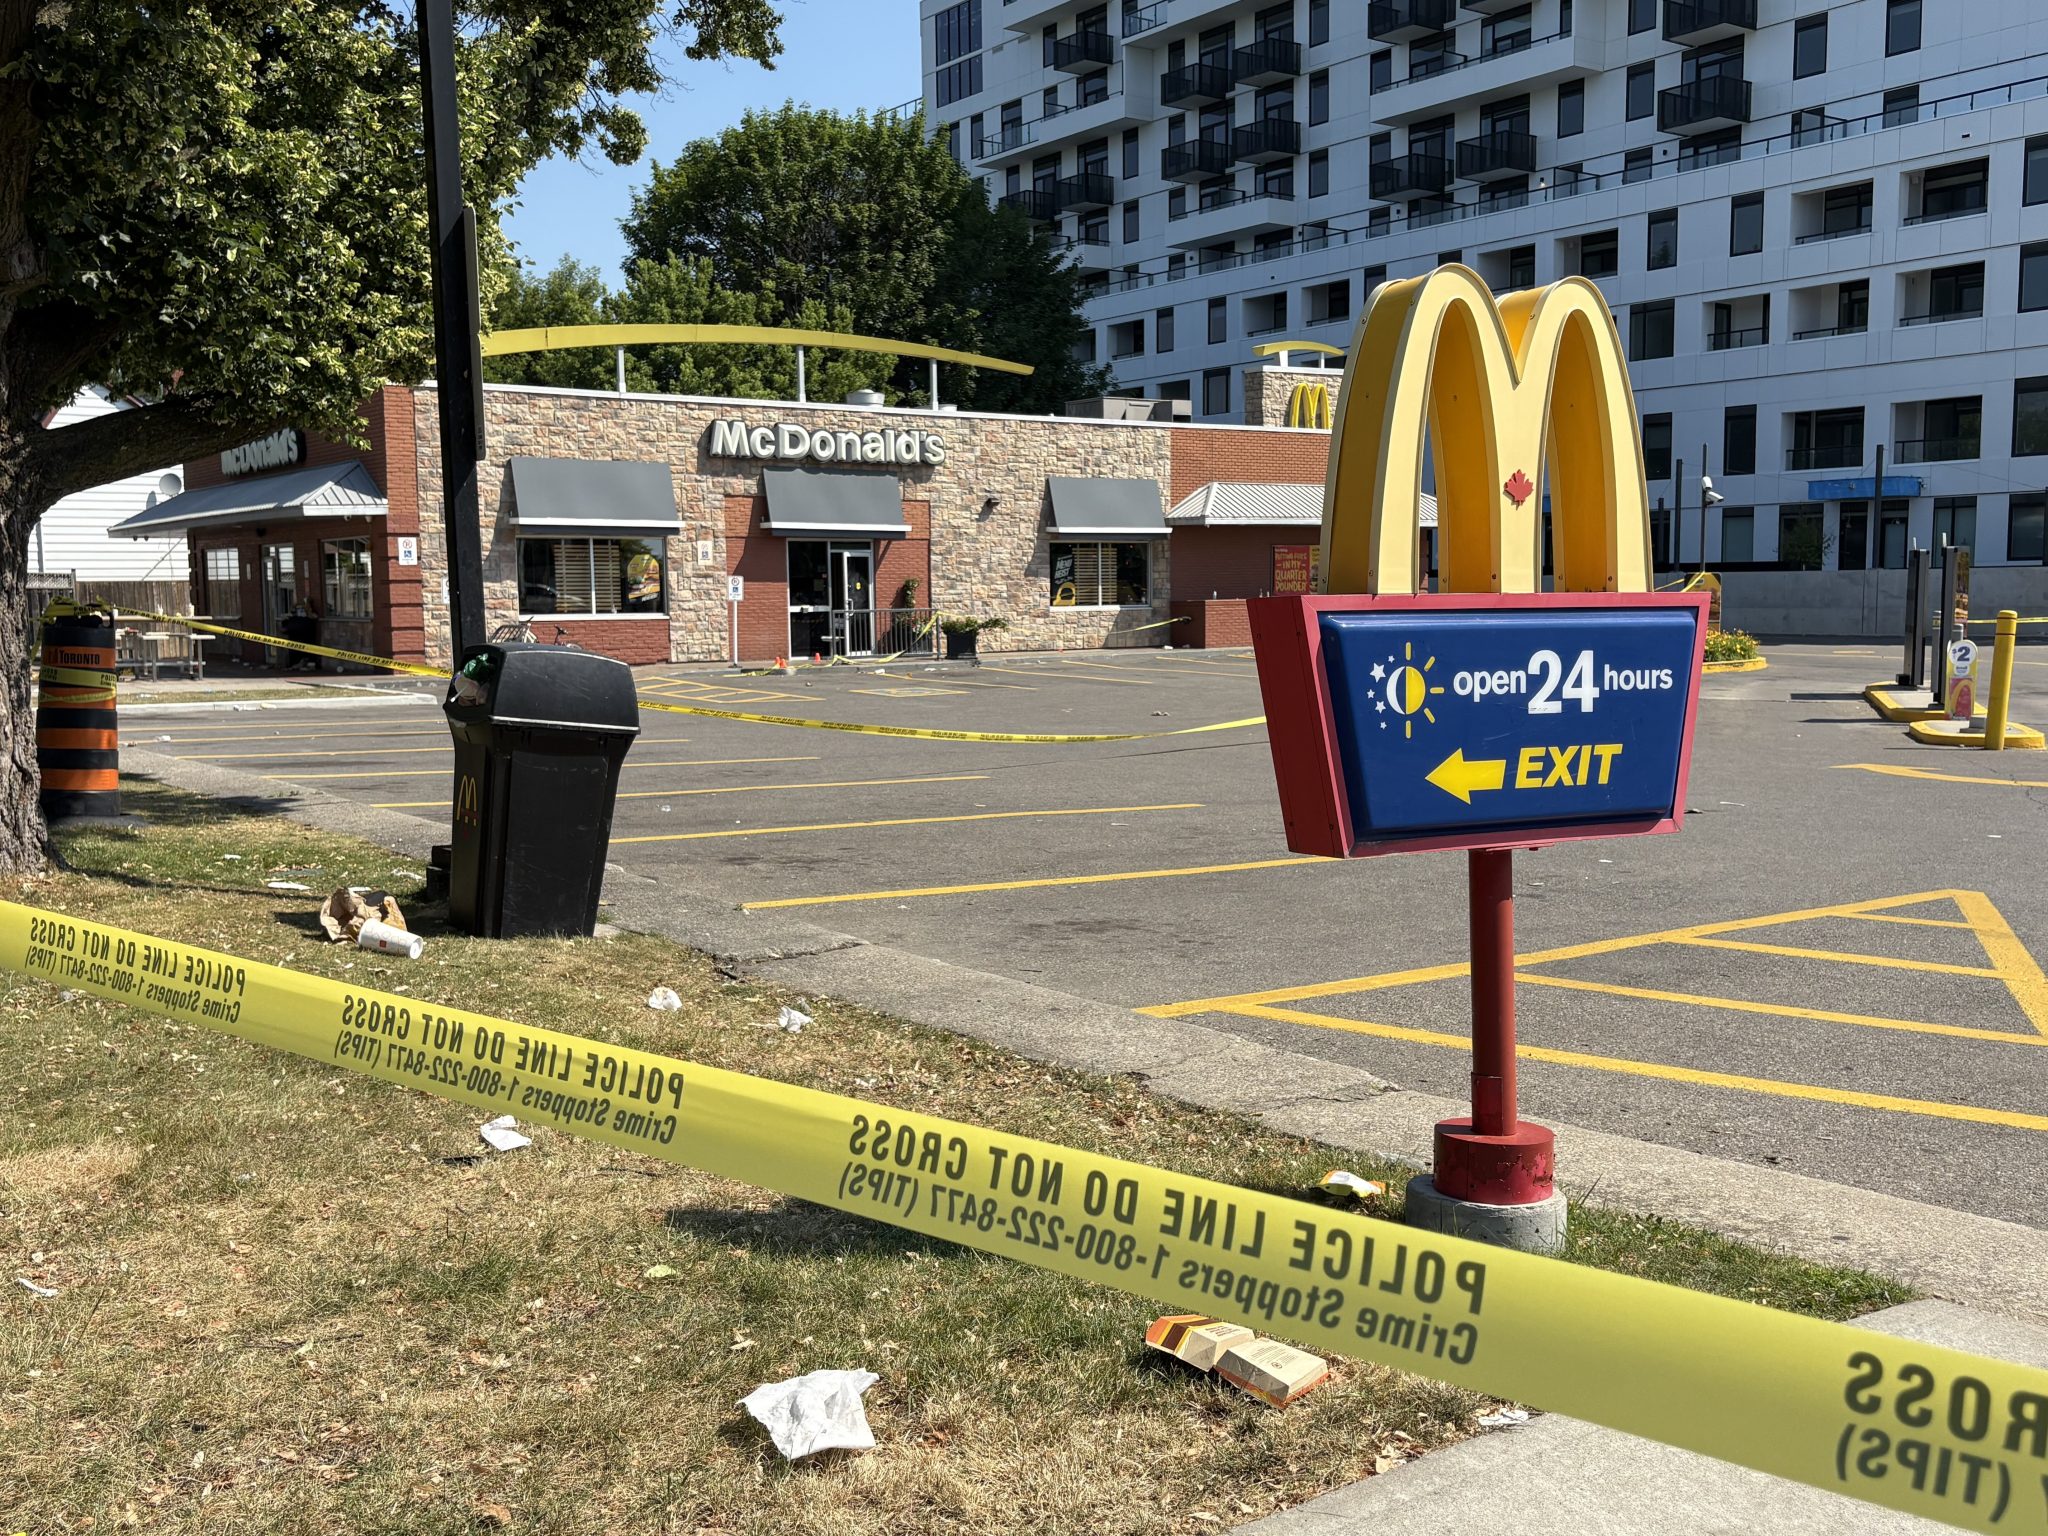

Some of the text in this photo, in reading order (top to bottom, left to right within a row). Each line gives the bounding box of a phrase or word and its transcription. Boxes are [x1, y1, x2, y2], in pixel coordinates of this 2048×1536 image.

[710, 418, 945, 466] McDonald's
[59, 648, 101, 665] TORONTO
[1453, 649, 1674, 714] open 24 hours
[1515, 743, 1623, 789] EXIT
